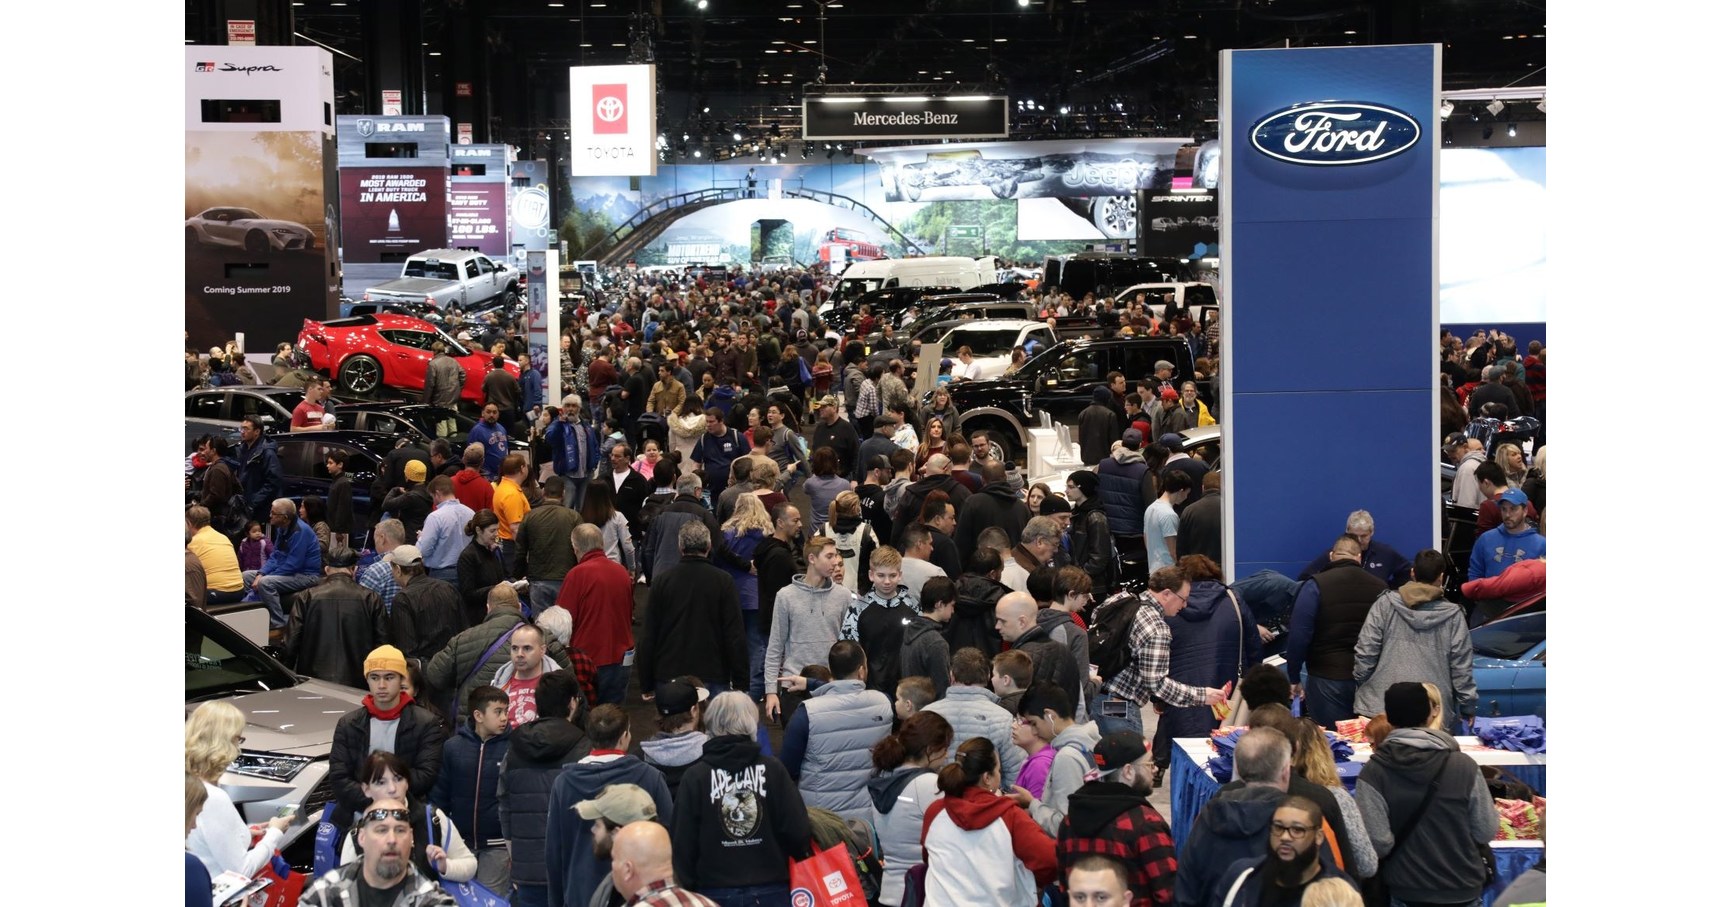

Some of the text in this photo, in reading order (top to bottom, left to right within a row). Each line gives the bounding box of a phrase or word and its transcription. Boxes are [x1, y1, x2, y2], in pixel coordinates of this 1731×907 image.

[218, 62, 282, 76] Supra
[853, 111, 958, 126] Mercedes-Benz
[377, 123, 425, 132] RAM
[1284, 111, 1388, 153] Ford
[455, 149, 491, 157] RAM
[586, 146, 634, 159] TOYOTA
[1062, 161, 1136, 190] Jeep
[385, 179, 426, 187] AWARDED
[360, 192, 427, 202] IN AMERICA
[475, 225, 499, 233] LBS.
[668, 244, 720, 257] MOTORTREND
[204, 286, 236, 295] Coming
[710, 768, 733, 804] APE
[830, 892, 854, 906] TOYOTA
